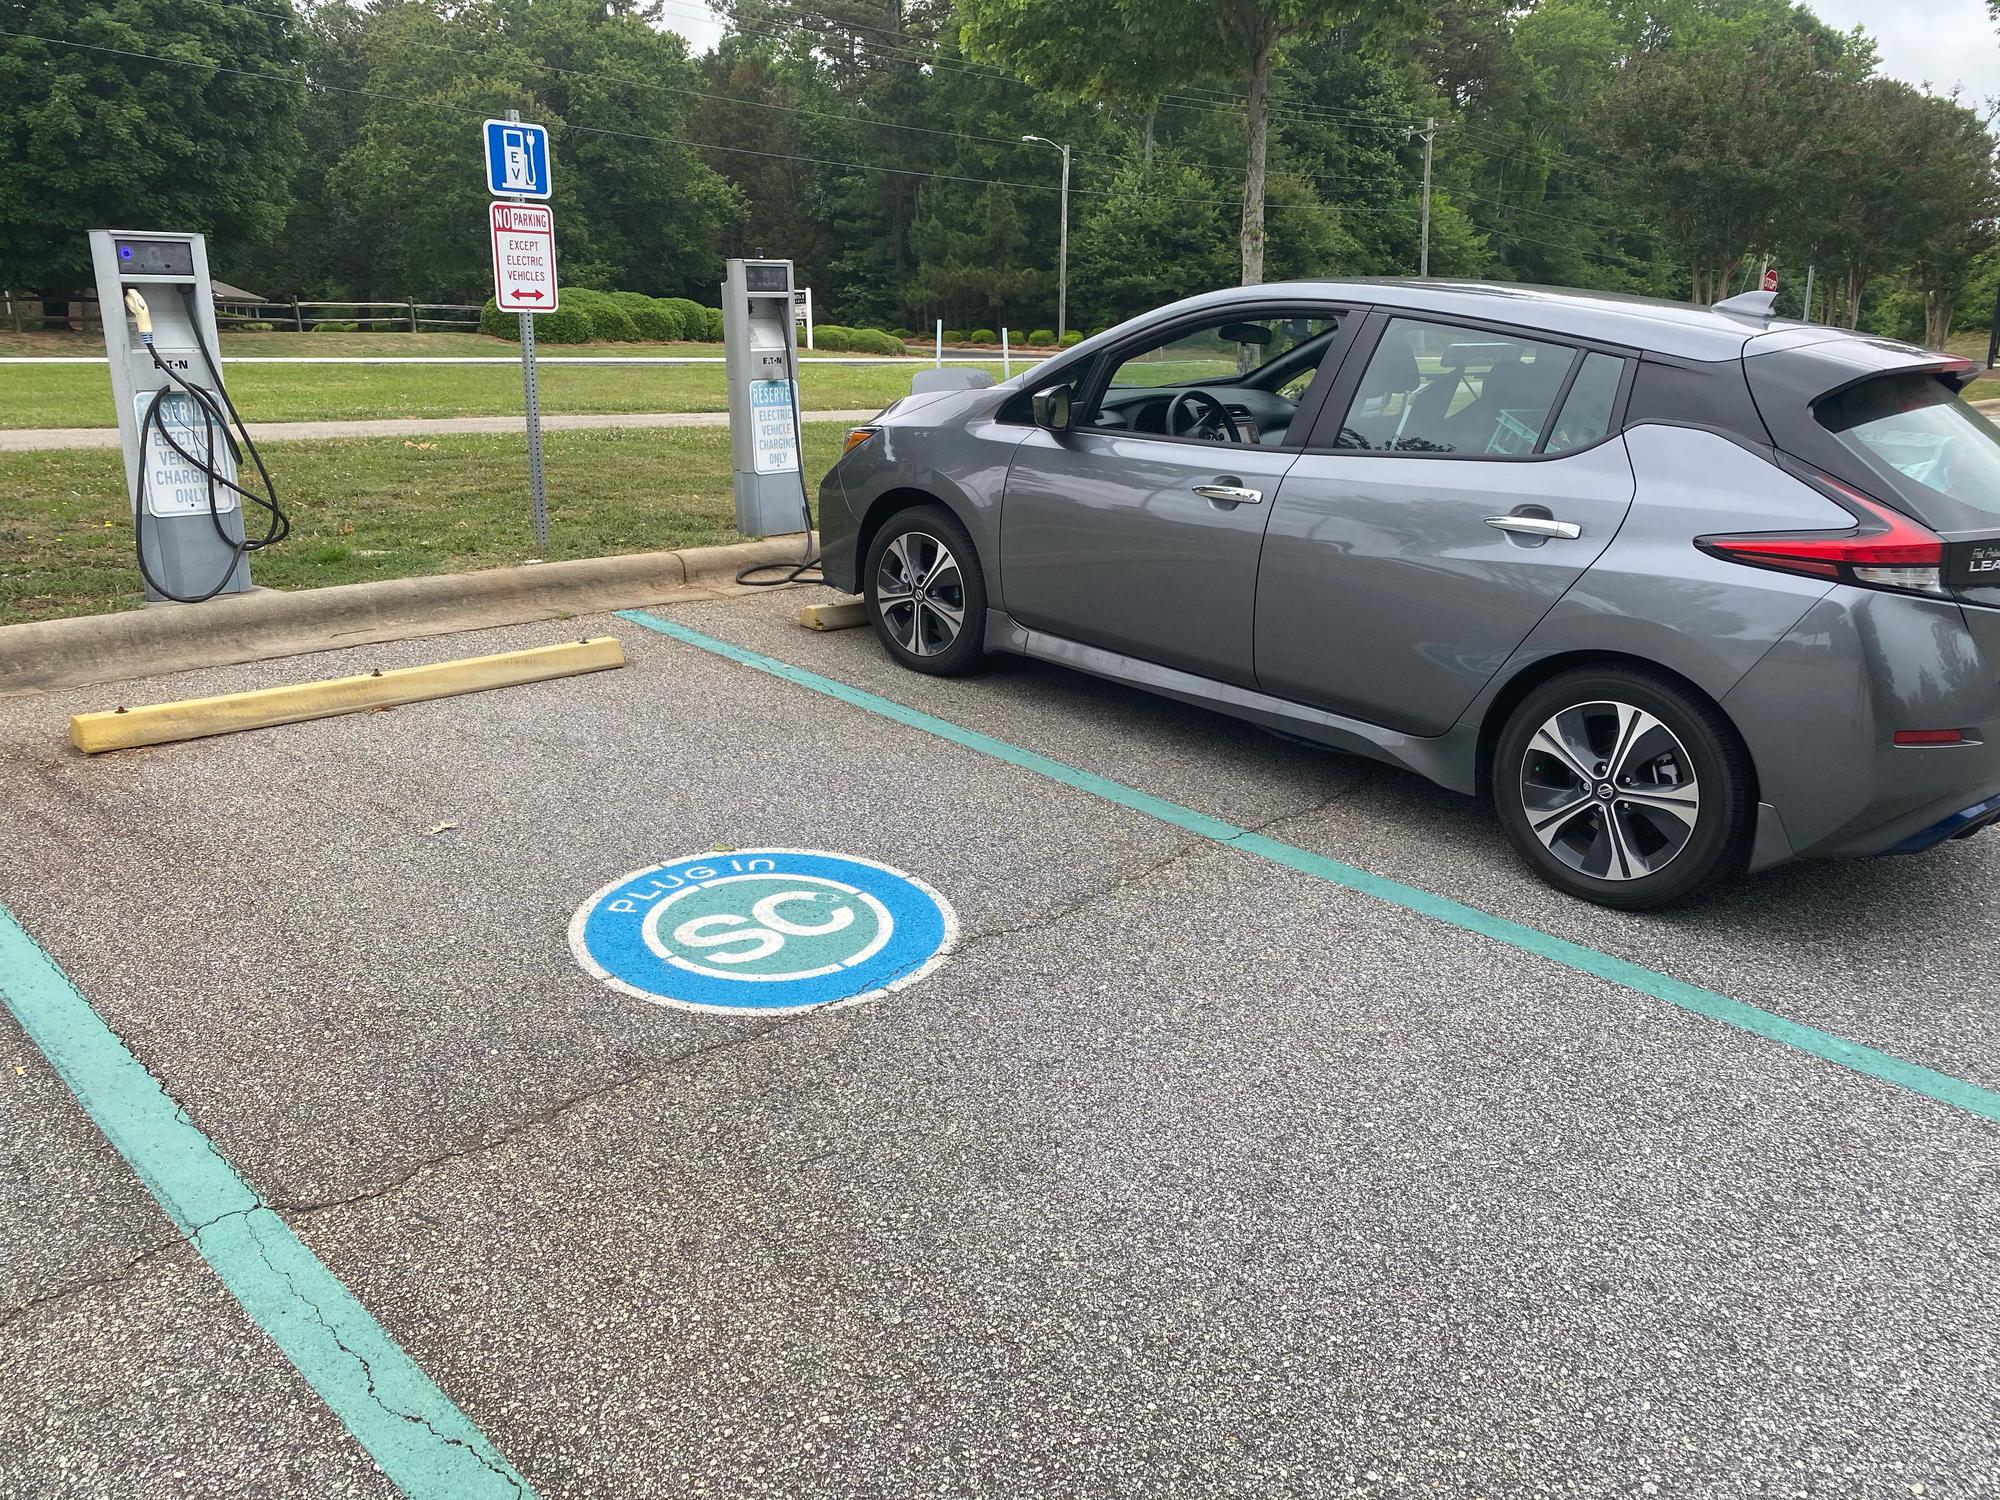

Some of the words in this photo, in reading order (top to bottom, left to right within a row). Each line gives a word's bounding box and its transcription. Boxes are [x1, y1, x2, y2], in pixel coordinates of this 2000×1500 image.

[495, 208, 511, 229] NO
[513, 214, 547, 229] PARKING
[509, 240, 539, 251] EXCEPT
[507, 255, 544, 267] ELECTRIC
[507, 270, 545, 282] VEHICLES
[753, 387, 794, 404] RESERVE
[759, 409, 793, 421] ELECTRIC
[762, 424, 792, 435] VEHICLE
[759, 437, 796, 450] CHARGING
[769, 453, 787, 465] ONLY
[156, 468, 217, 485] CHARGI
[176, 487, 208, 503] ONLY
[608, 866, 717, 913] PLUG
[673, 891, 855, 964] SC
